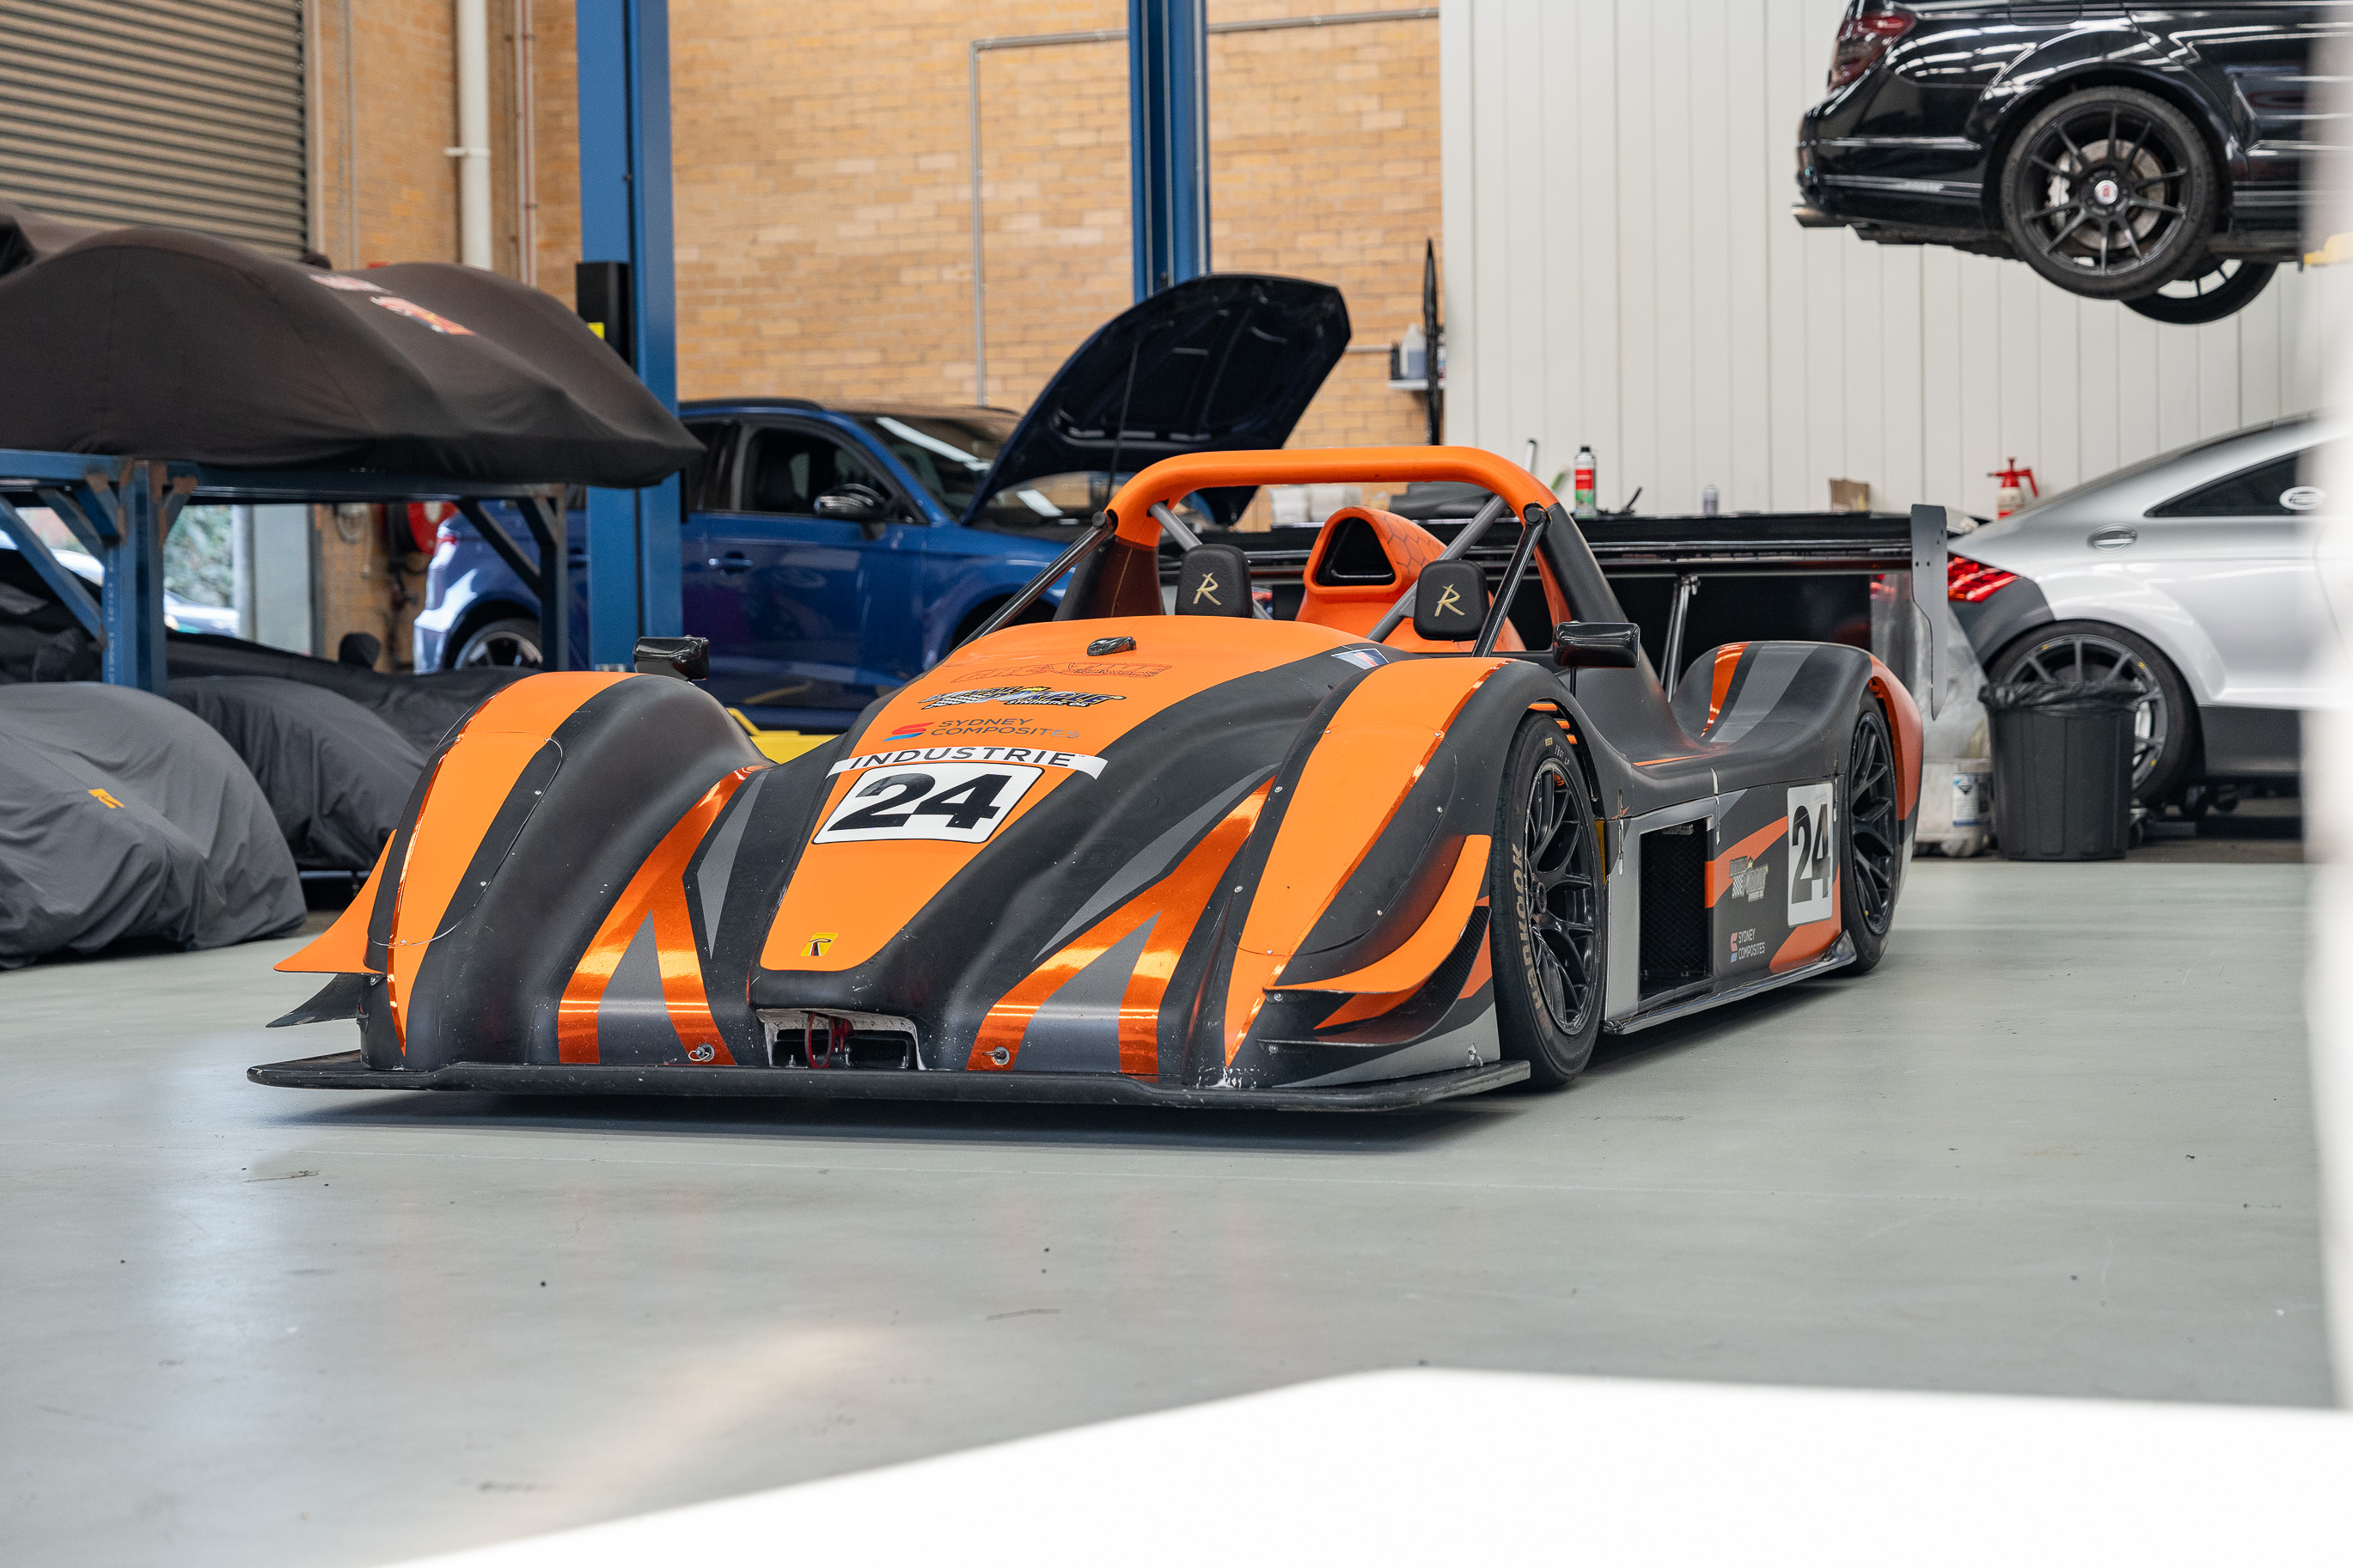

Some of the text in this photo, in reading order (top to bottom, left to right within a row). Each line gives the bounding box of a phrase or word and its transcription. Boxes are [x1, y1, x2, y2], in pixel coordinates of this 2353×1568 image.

[1193, 572, 1221, 606] R
[1434, 583, 1465, 617] R
[931, 726, 1081, 739] COMPOSITES
[938, 718, 1034, 728] SYDNEY
[849, 747, 1076, 767] INDUSTRIE
[827, 773, 1013, 832] 24
[1791, 803, 1831, 905] 24
[1738, 928, 1756, 944] SYDNEY
[1738, 942, 1766, 960] COMPOSITES
